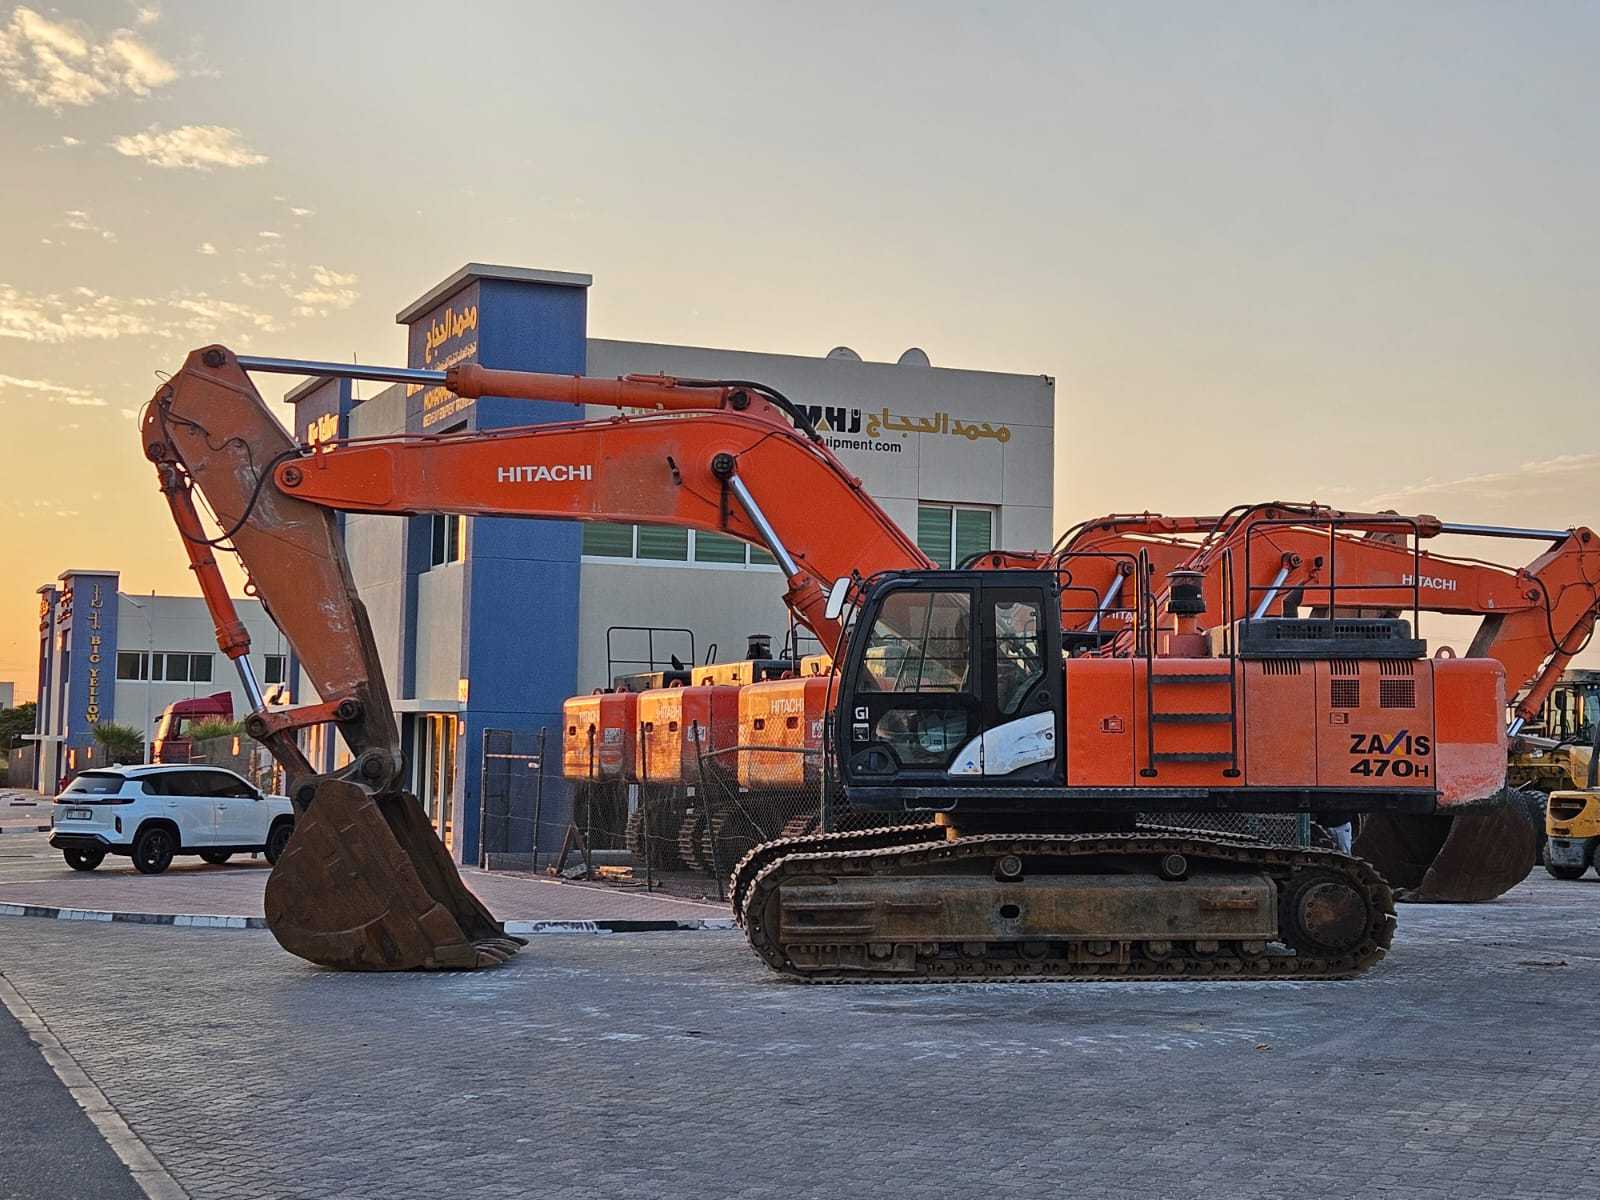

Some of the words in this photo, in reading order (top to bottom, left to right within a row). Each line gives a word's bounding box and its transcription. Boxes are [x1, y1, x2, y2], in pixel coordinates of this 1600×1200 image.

[866, 407, 949, 439] الحجاج
[951, 419, 1011, 443] محمد
[497, 464, 593, 483] HITACHI
[1402, 573, 1457, 591] HITACHI
[88, 635, 103, 663] BIG
[85, 667, 101, 723] YELLOW
[770, 698, 803, 714] HITACHI
[1349, 729, 1431, 756] ZAXIS
